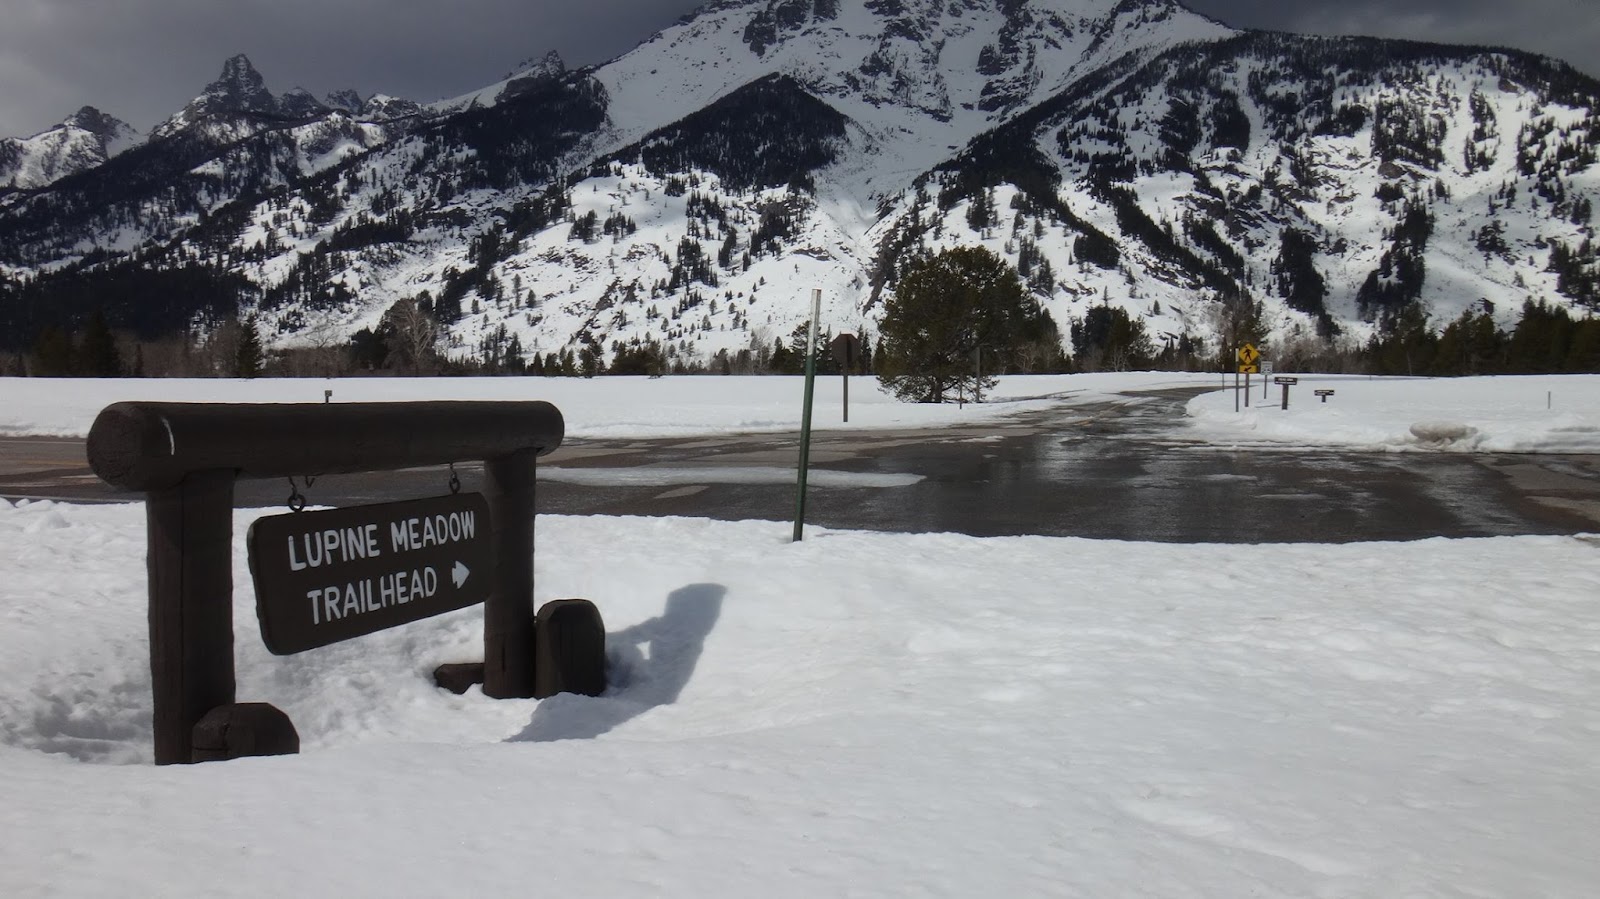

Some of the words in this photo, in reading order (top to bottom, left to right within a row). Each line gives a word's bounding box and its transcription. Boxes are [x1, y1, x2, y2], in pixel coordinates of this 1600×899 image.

[287, 524, 380, 571] LUPINE
[390, 510, 475, 553] MEADOW
[307, 566, 438, 625] TRAILHEAD
